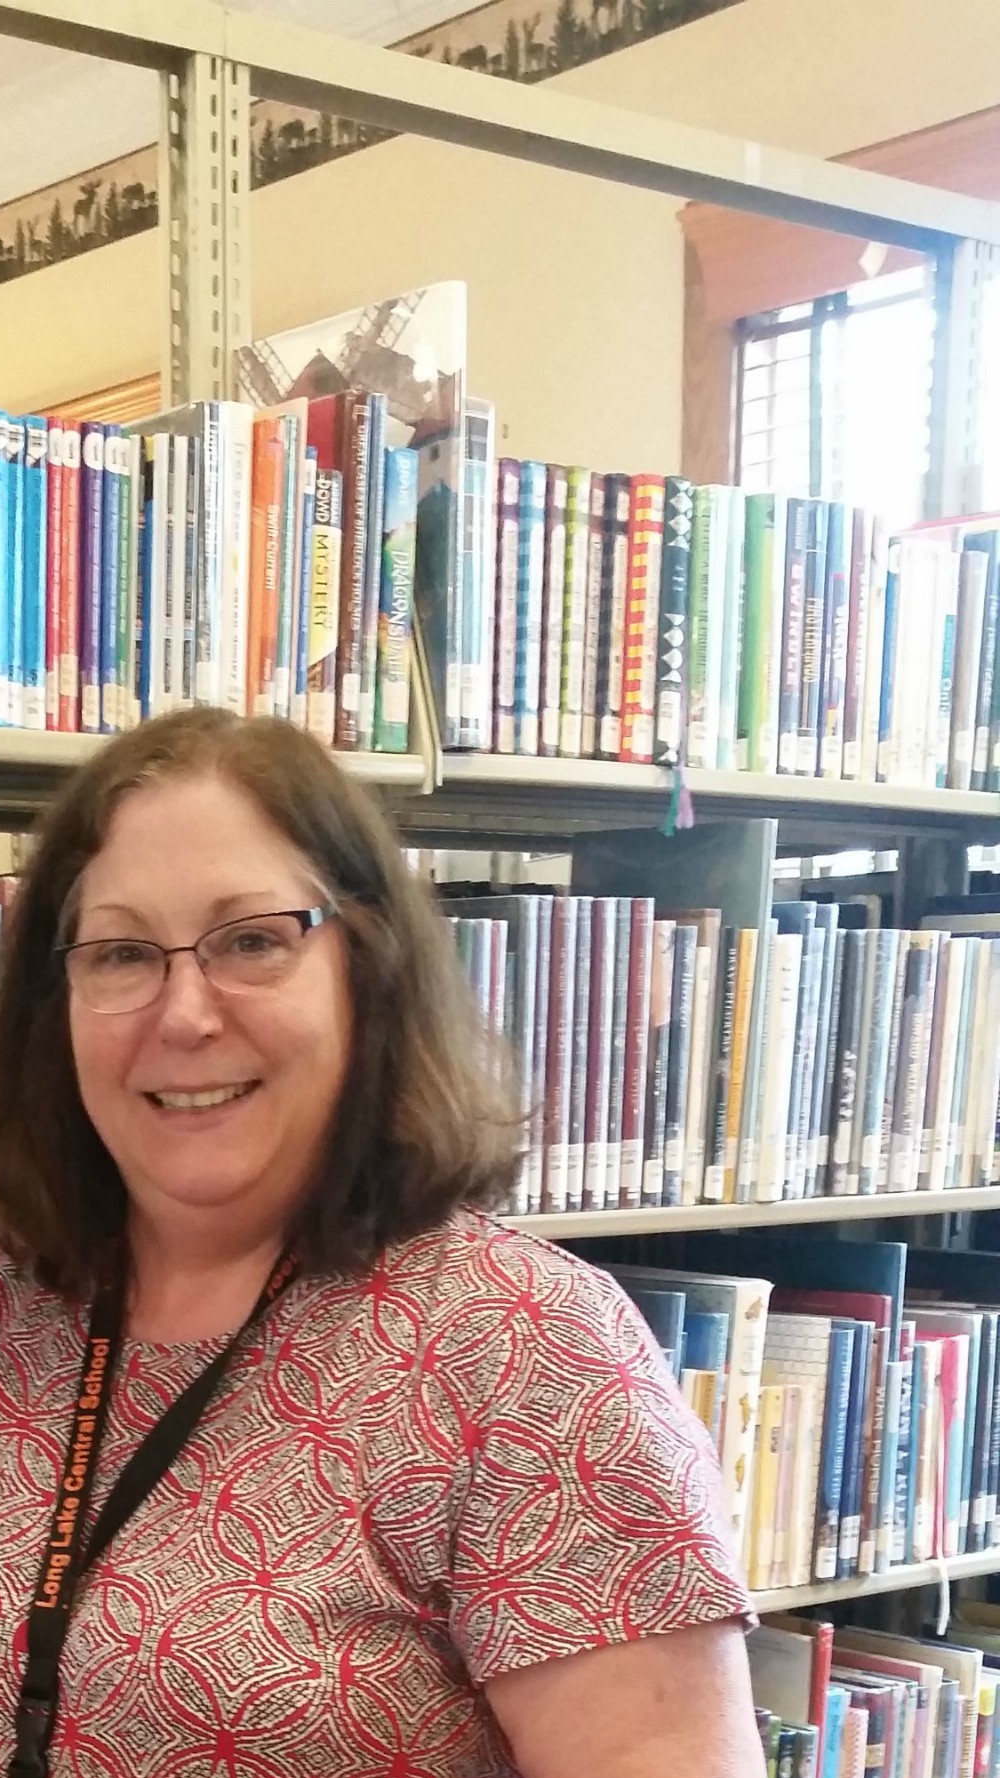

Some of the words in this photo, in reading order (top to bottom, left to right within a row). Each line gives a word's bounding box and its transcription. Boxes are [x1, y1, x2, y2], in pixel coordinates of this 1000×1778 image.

[78, 1338, 111, 1411] School
[63, 1414, 97, 1492] Central
[50, 1497, 80, 1548] Lake
[35, 1553, 72, 1609] Long
